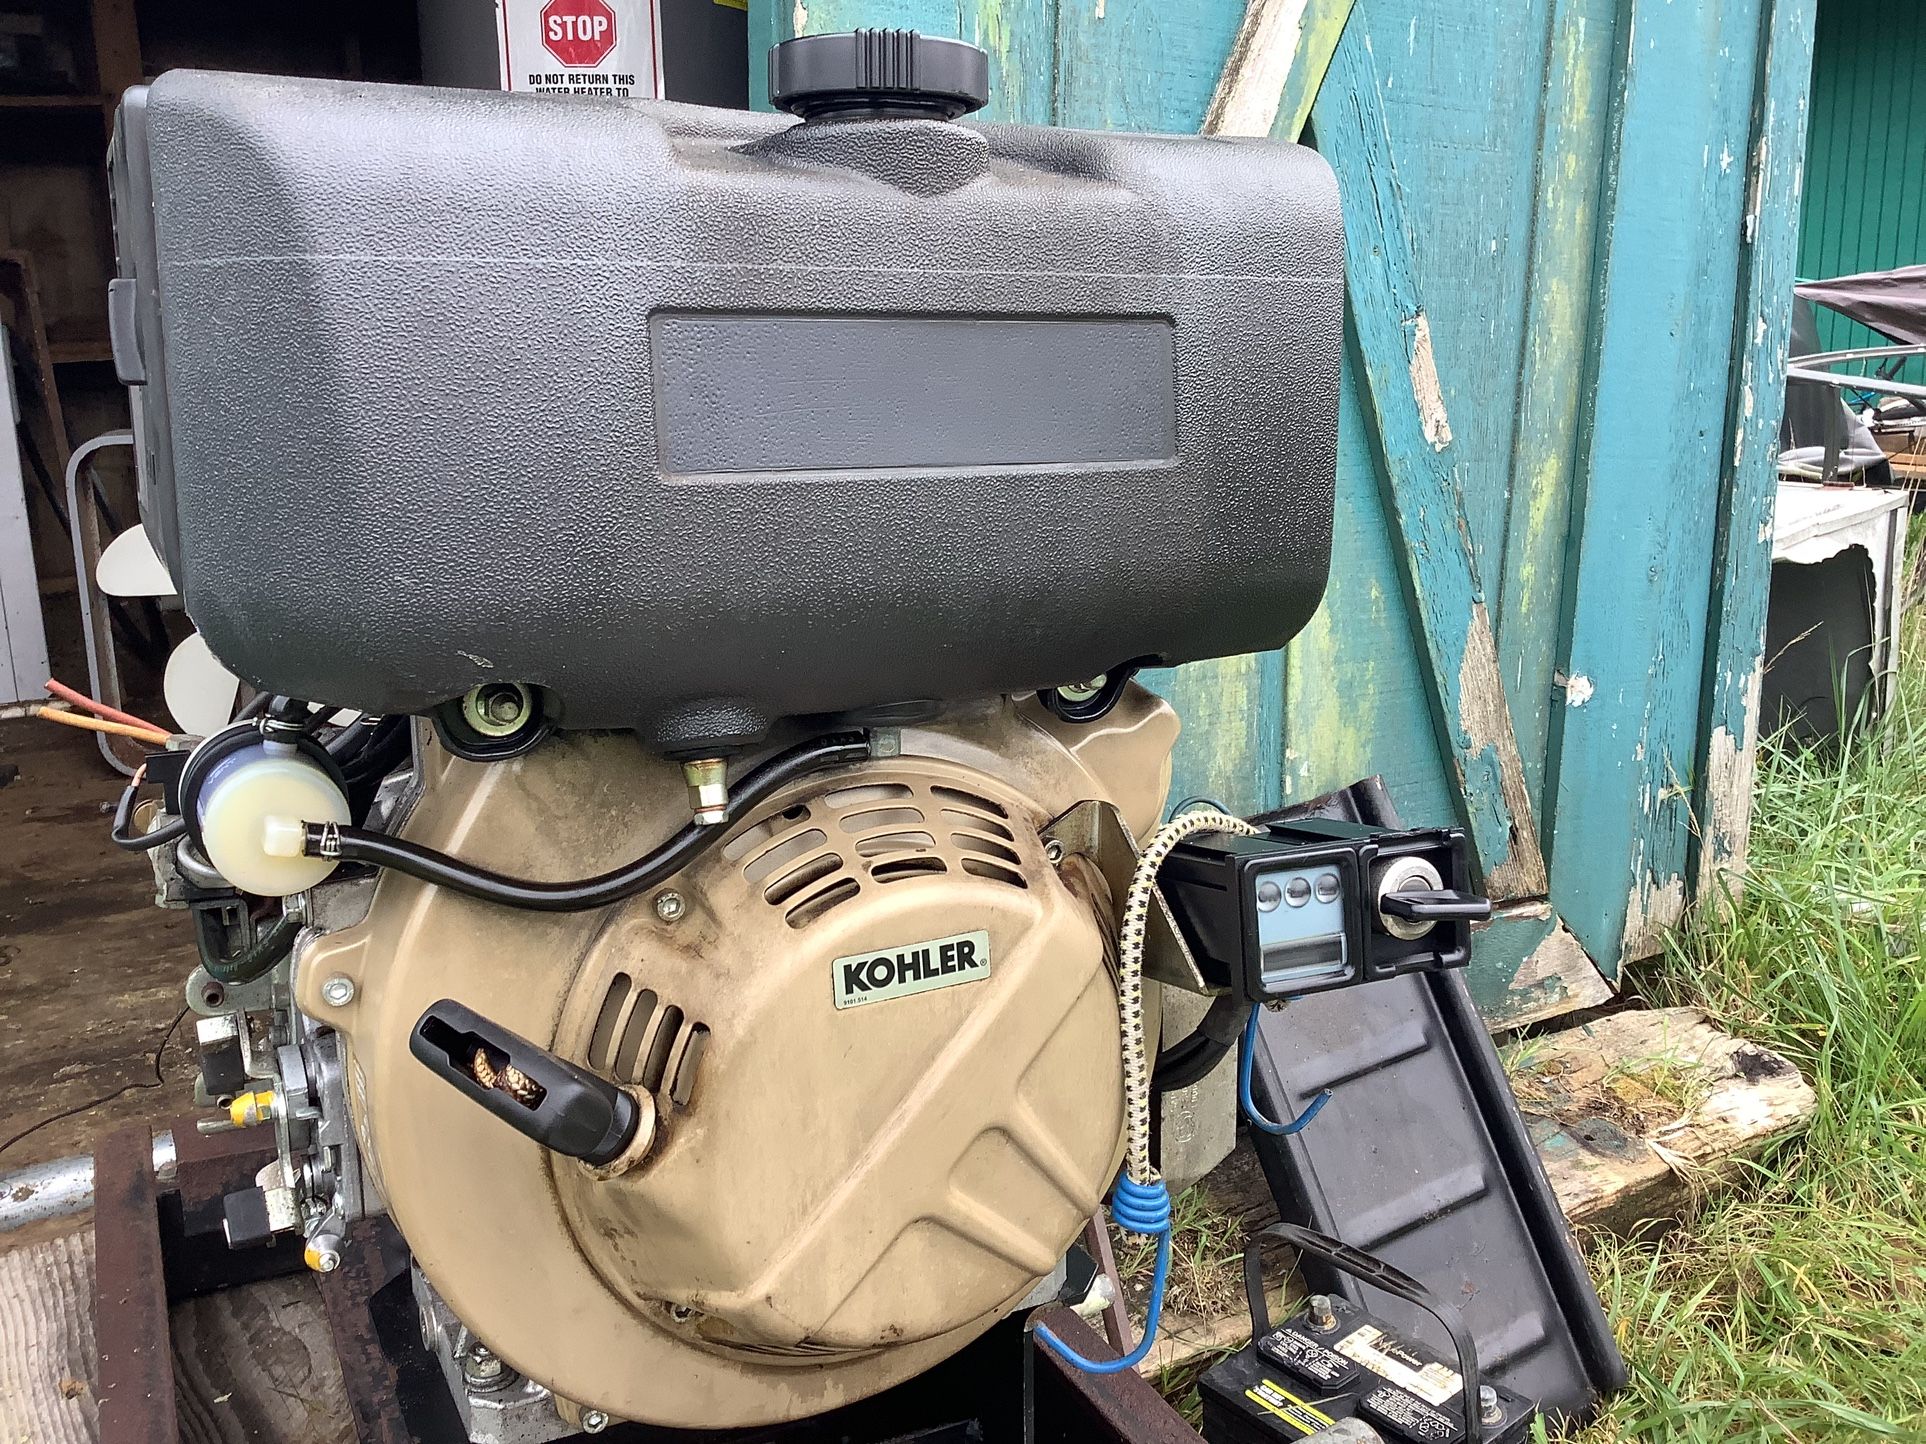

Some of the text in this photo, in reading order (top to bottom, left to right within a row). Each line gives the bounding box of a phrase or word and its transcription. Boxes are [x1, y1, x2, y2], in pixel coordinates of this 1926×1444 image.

[548, 15, 608, 41] STOP
[529, 74, 635, 85] DO NOT RETURN THIS
[573, 87, 613, 96] HEATER
[616, 87, 629, 97] TO
[1291, 1330, 1319, 1349] DANGER
[1322, 1349, 1349, 1366] POISON
